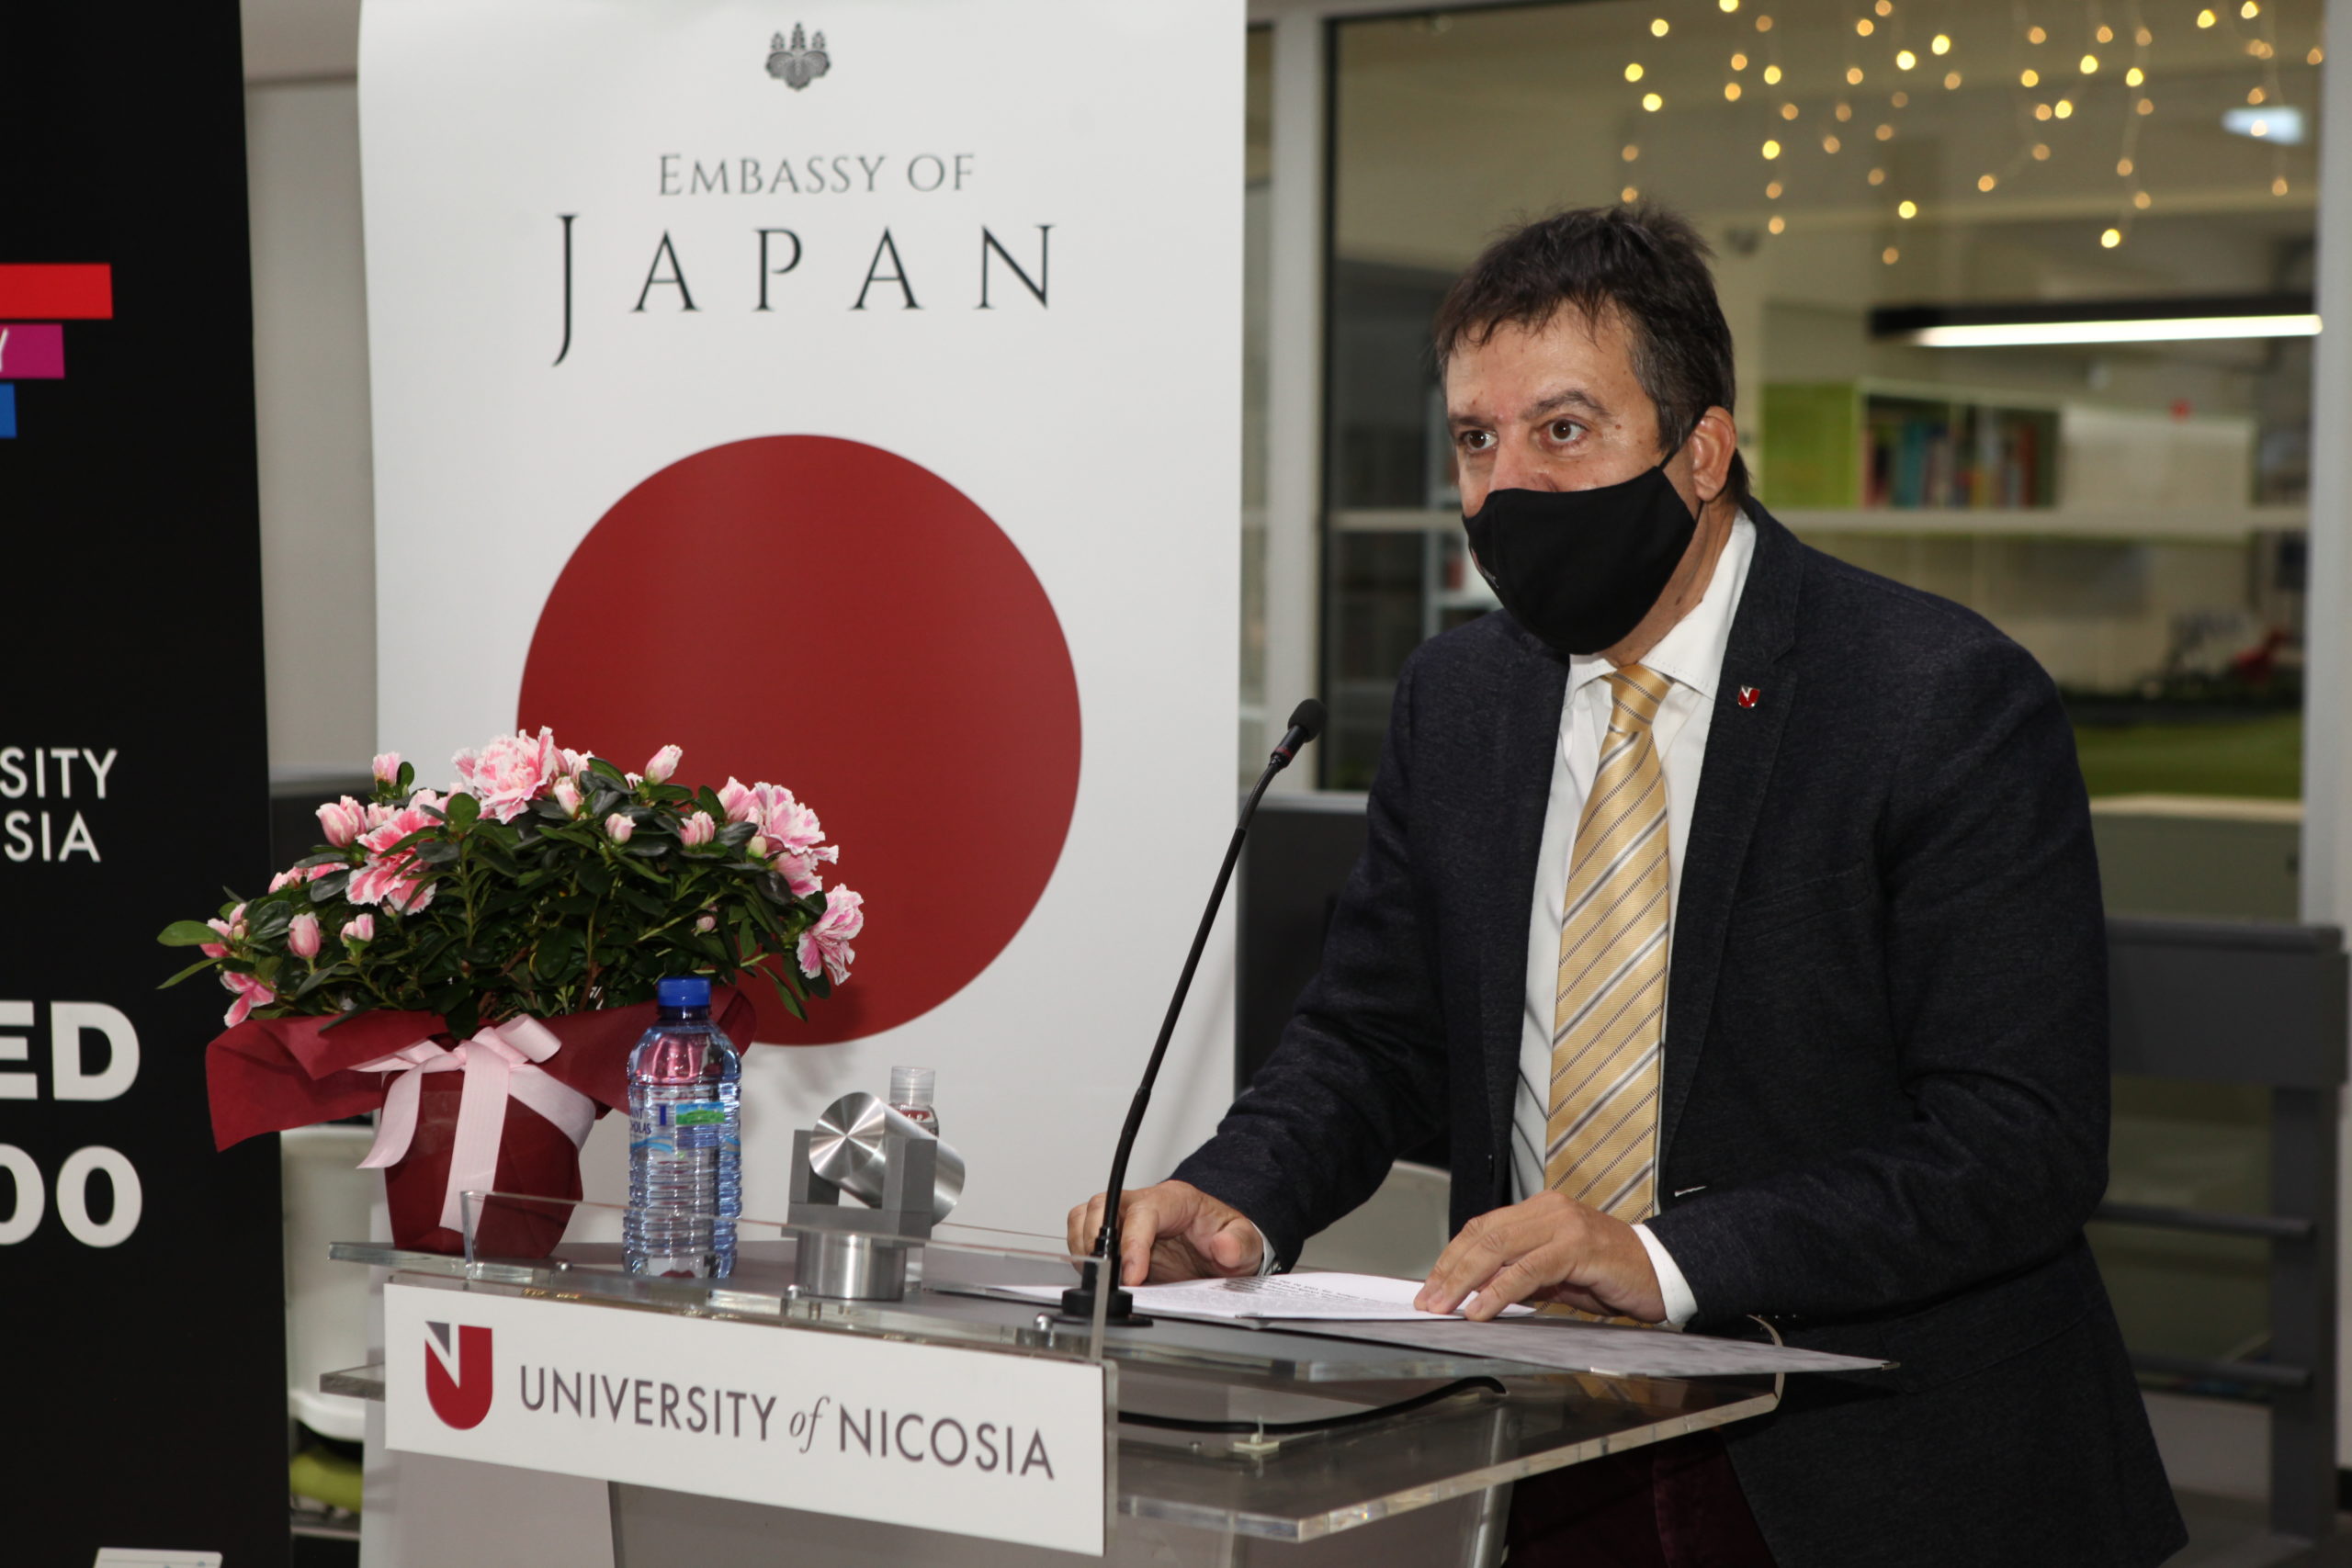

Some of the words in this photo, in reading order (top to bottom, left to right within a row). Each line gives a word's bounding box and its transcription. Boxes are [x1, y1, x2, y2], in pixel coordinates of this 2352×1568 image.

[659, 153, 887, 197] EMBASSY
[907, 153, 975, 192] OF
[552, 213, 1057, 367] JAPAN
[0, 746, 118, 799] SITY
[5, 809, 101, 863] SIA
[520, 1365, 777, 1442] UNIVERSITY
[788, 1395, 831, 1454] of
[840, 1406, 1056, 1481] NICOSIA
